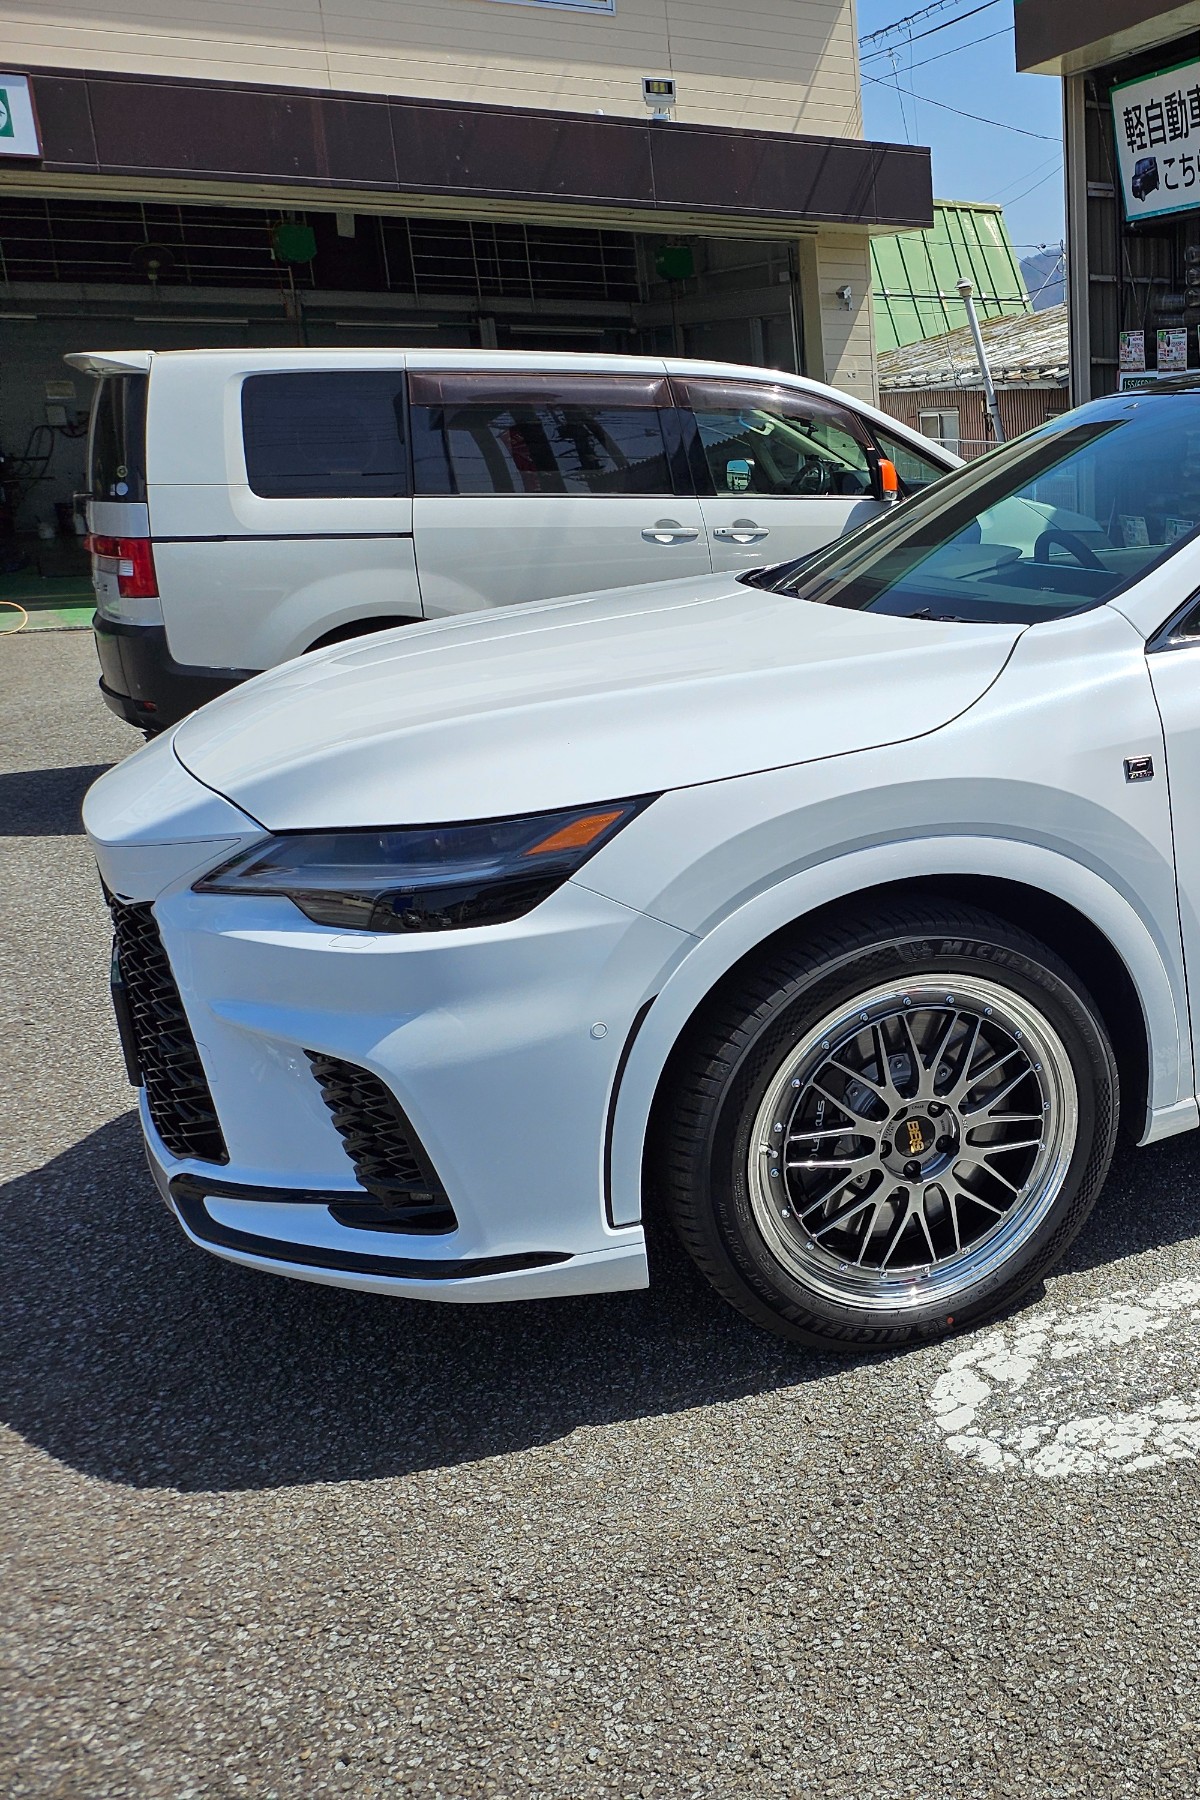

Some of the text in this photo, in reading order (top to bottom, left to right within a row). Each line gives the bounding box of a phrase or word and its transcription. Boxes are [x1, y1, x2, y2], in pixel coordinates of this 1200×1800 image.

[941, 940, 1061, 993] MICHELIN
[906, 1120, 925, 1153] BBS
[780, 1304, 912, 1344] MICHELIN
